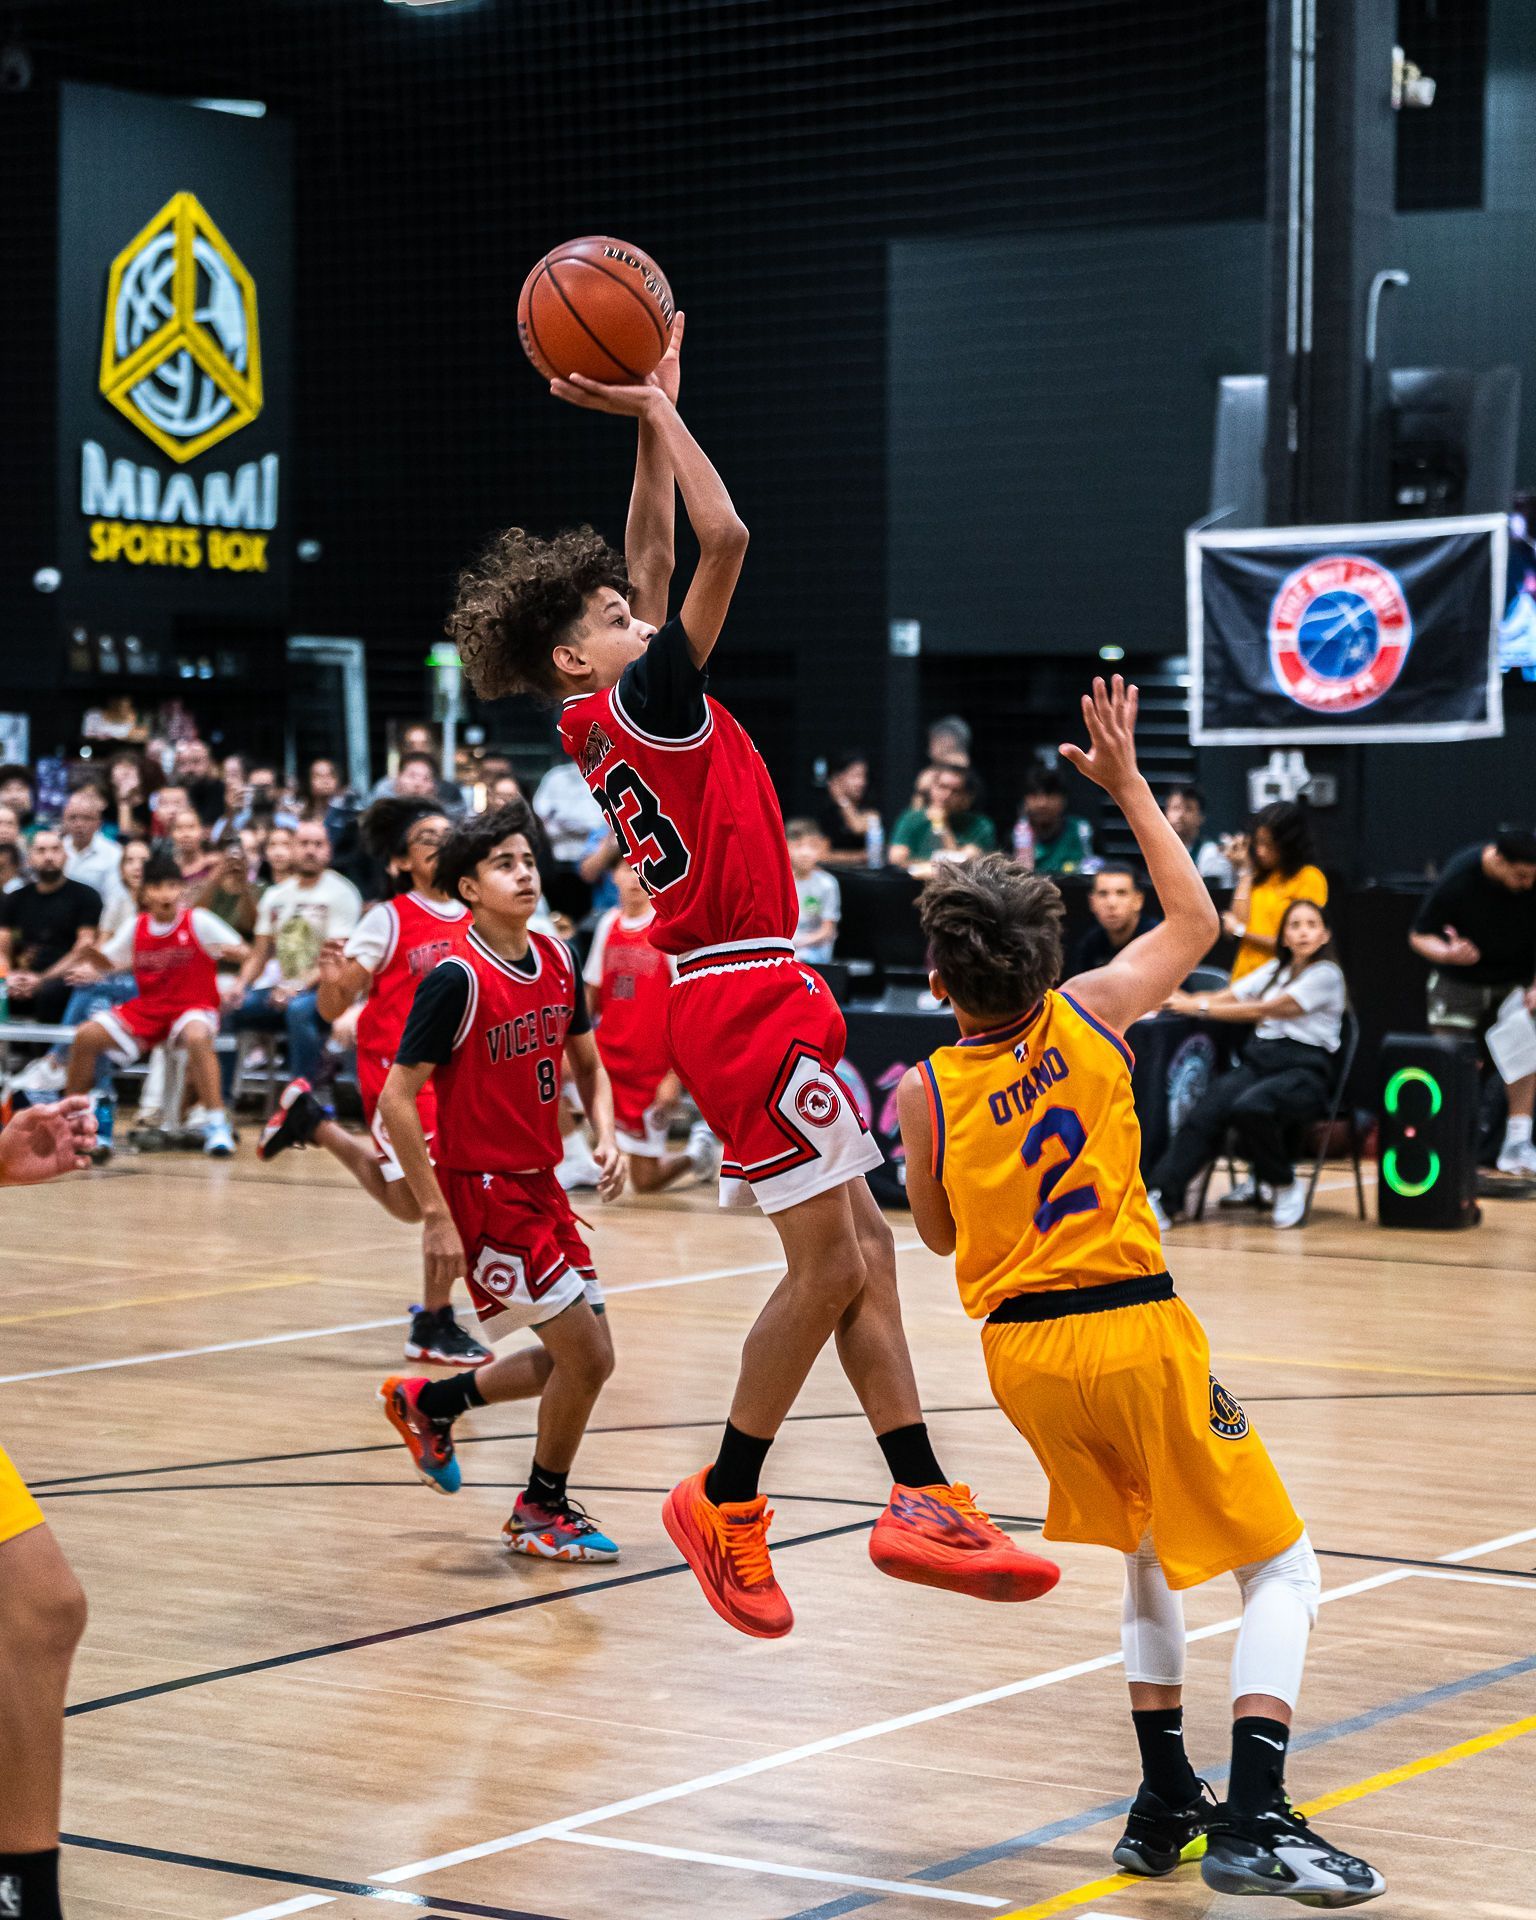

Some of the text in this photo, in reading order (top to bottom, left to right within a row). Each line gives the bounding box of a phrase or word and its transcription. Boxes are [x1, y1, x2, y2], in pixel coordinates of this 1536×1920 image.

[81, 439, 279, 530] MIAMI
[90, 521, 269, 572] SPORTS BOX
[486, 1010, 540, 1065] VICE
[535, 1057, 556, 1105] 8
[1020, 1104, 1102, 1234] 2
